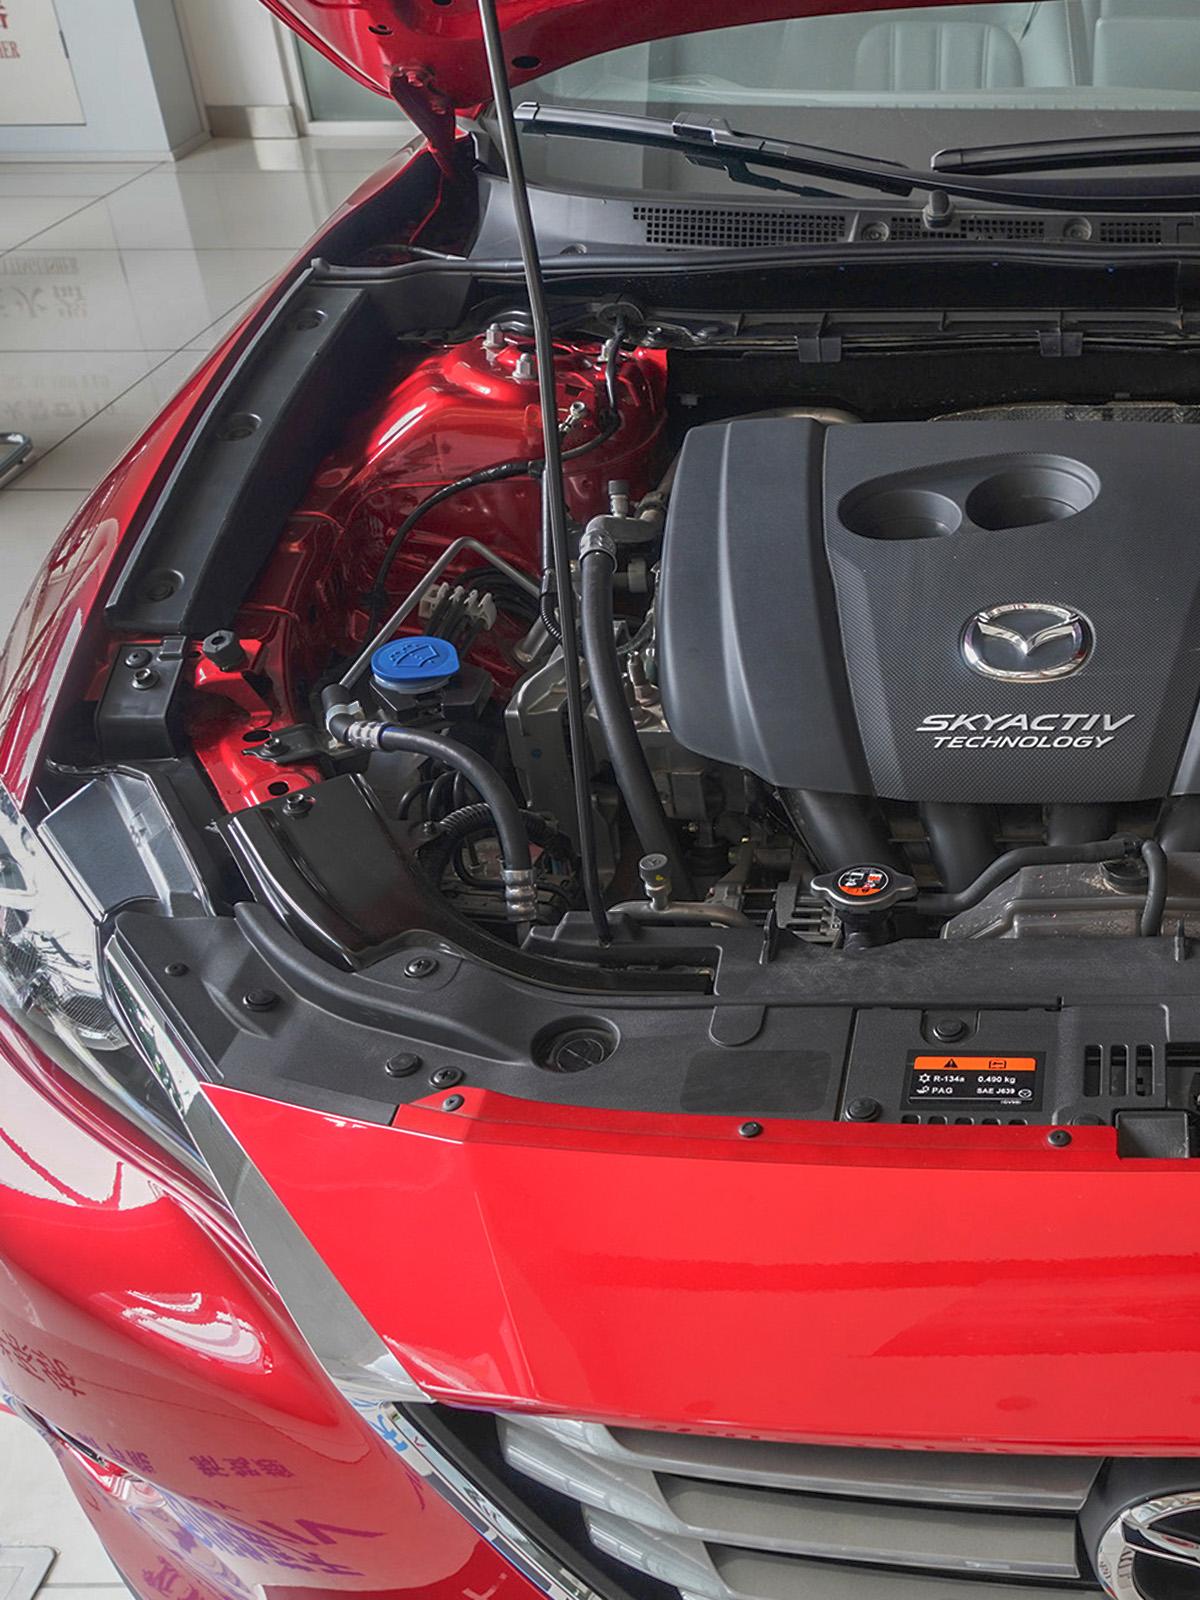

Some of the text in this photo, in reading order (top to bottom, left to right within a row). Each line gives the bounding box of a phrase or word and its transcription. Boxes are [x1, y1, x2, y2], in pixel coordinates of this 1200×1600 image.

[916, 714, 1135, 731] SKYACTIV
[934, 736, 1115, 748] TECHNOLOGY
[933, 1075, 1016, 1085] R-134a 0.490 kg
[931, 1087, 1016, 1095] PAG SAE J639
